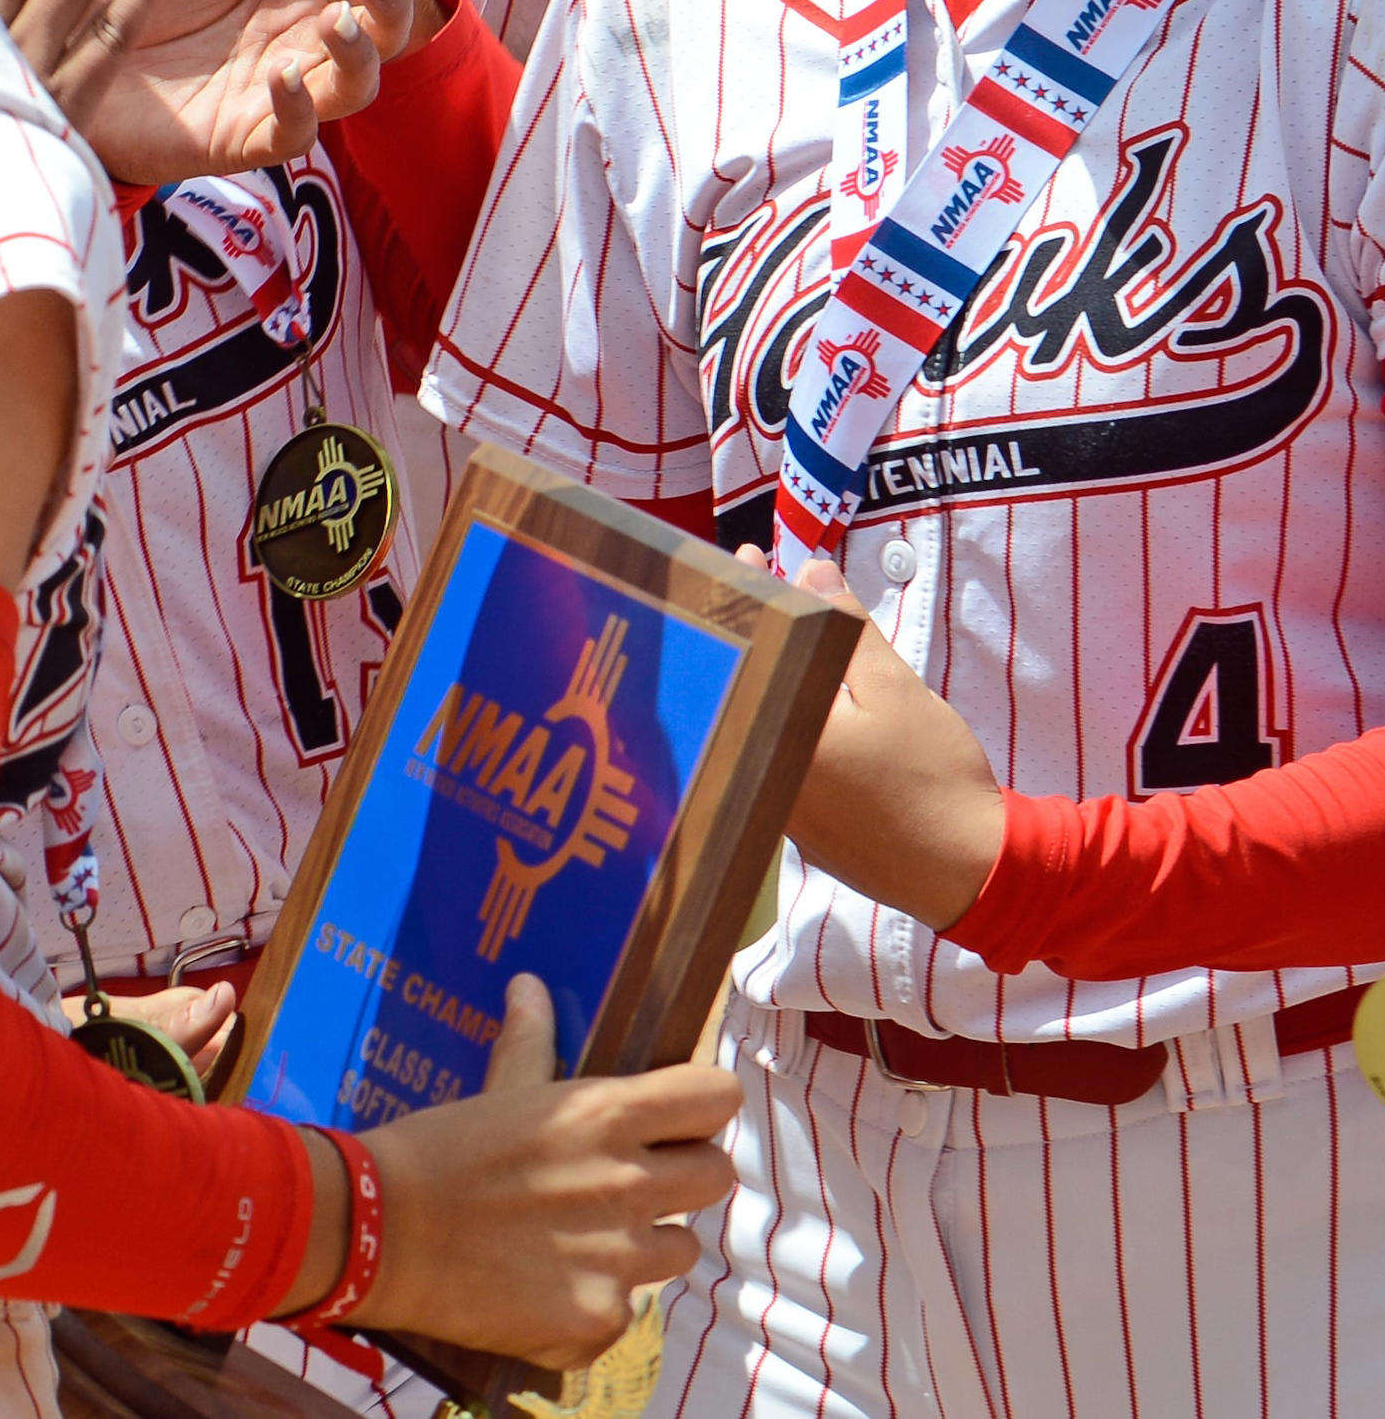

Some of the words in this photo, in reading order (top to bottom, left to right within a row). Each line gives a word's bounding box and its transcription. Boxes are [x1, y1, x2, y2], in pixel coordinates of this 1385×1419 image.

[865, 99, 880, 187] NMAA
[176, 190, 257, 247] NMAA
[930, 160, 996, 246] NMAA
[811, 354, 862, 440] NMAA
[257, 475, 348, 533] NMAA
[286, 576, 320, 594] STATE
[1125, 601, 1296, 803] 4
[414, 681, 588, 830] NMAA
[316, 921, 402, 993] STATE
[402, 972, 506, 1047] CHAMP
[359, 1027, 434, 1093] CLASS
